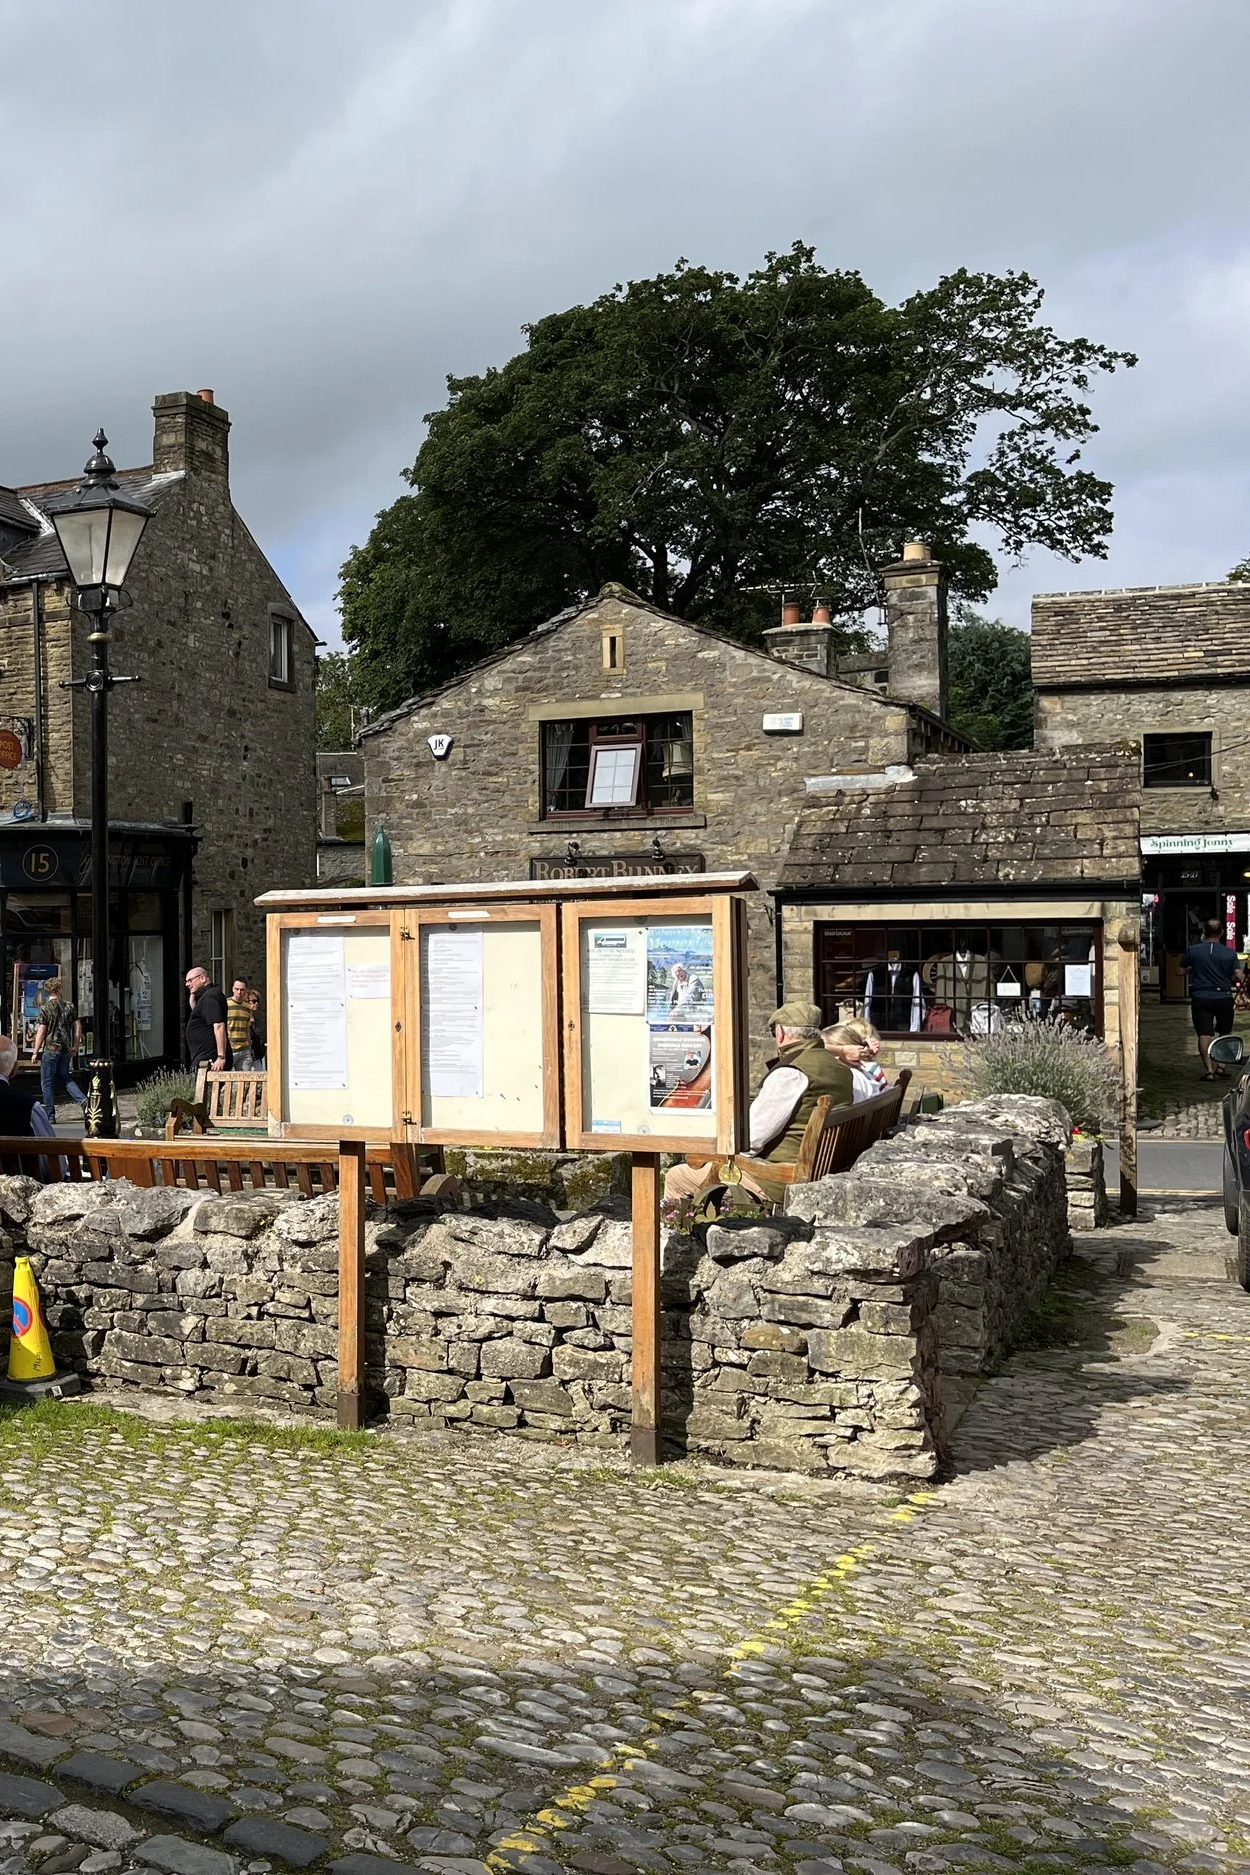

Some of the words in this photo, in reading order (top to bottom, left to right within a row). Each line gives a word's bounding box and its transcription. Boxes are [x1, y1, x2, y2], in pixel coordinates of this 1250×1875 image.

[0, 739, 14, 751] POST
[434, 739, 444, 750] JK
[1150, 838, 1201, 851] Spinning
[30, 852, 50, 873] 15
[534, 860, 610, 880] ROBERT
[1226, 895, 1236, 914] Sale
[1226, 921, 1236, 940] Sale
